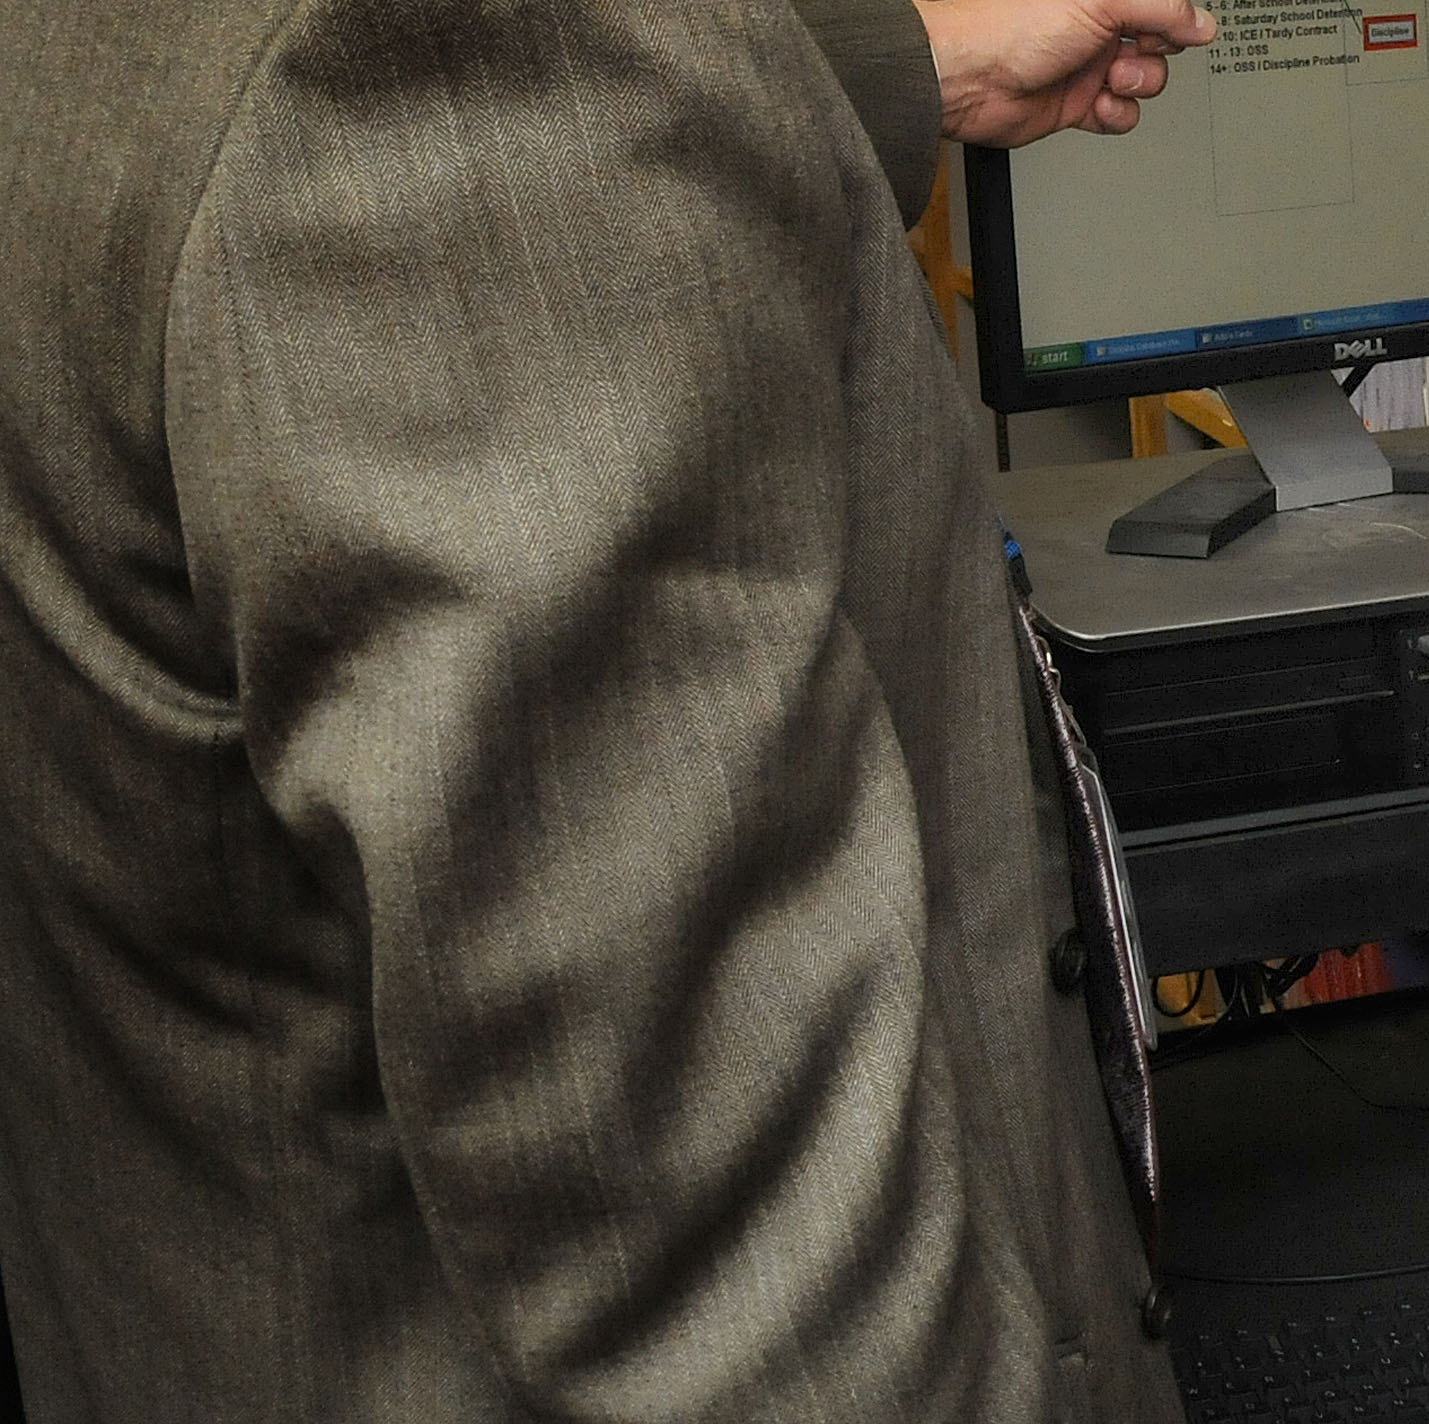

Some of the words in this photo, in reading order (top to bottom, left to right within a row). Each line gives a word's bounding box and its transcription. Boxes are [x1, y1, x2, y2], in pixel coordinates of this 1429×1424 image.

[1234, 13, 1278, 27] Saturday
[1280, 10, 1315, 23] School
[1317, 8, 1363, 19] Detention
[1240, 29, 1257, 41] ICE
[1265, 27, 1293, 40] Tardy
[1295, 25, 1338, 37] Contract
[1247, 45, 1269, 56] OSS
[1234, 62, 1257, 73] OSS
[1262, 58, 1311, 72] Discipline
[1313, 54, 1360, 66] Probation
[1334, 337, 1388, 360] DELL
[1042, 351, 1069, 364] start
